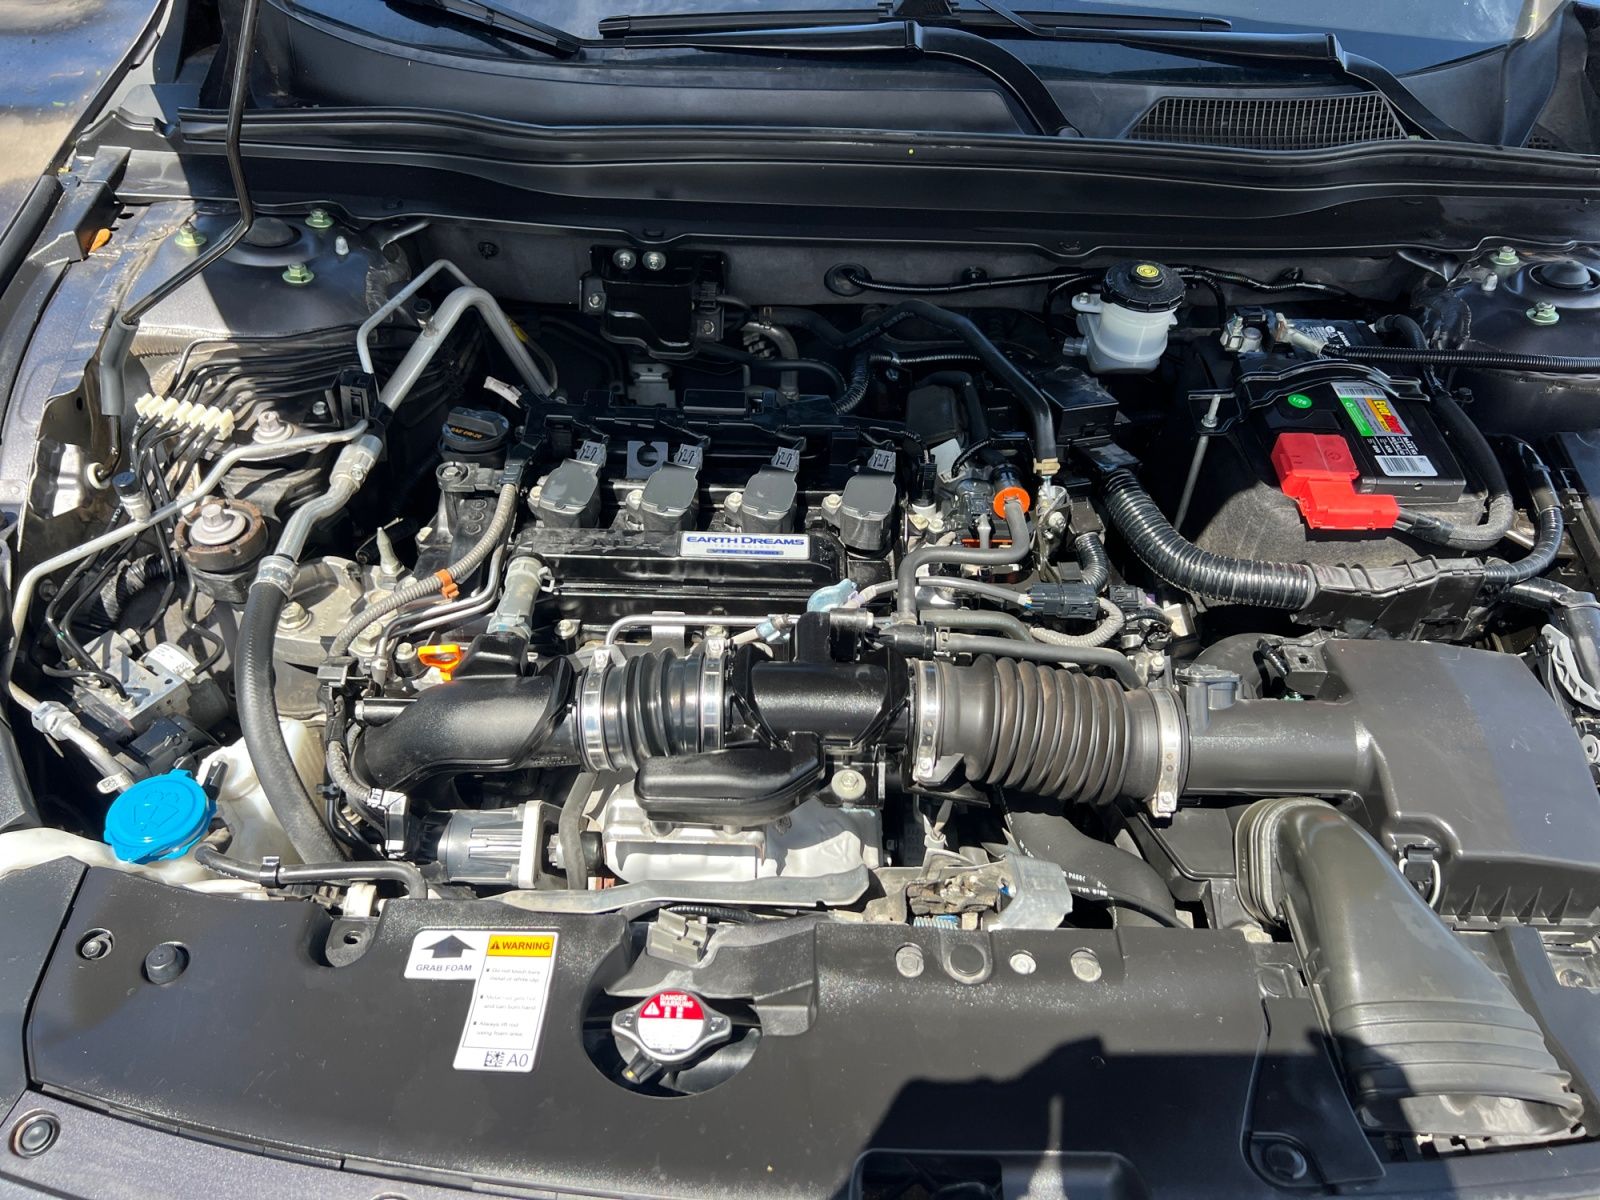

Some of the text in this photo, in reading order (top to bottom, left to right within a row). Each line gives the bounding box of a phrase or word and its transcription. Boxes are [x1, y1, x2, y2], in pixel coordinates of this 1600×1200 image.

[741, 537, 804, 545] DREAMS
[502, 941, 550, 950] WARNING
[416, 964, 472, 972] GRAB FOAM
[506, 1053, 529, 1067] A0
